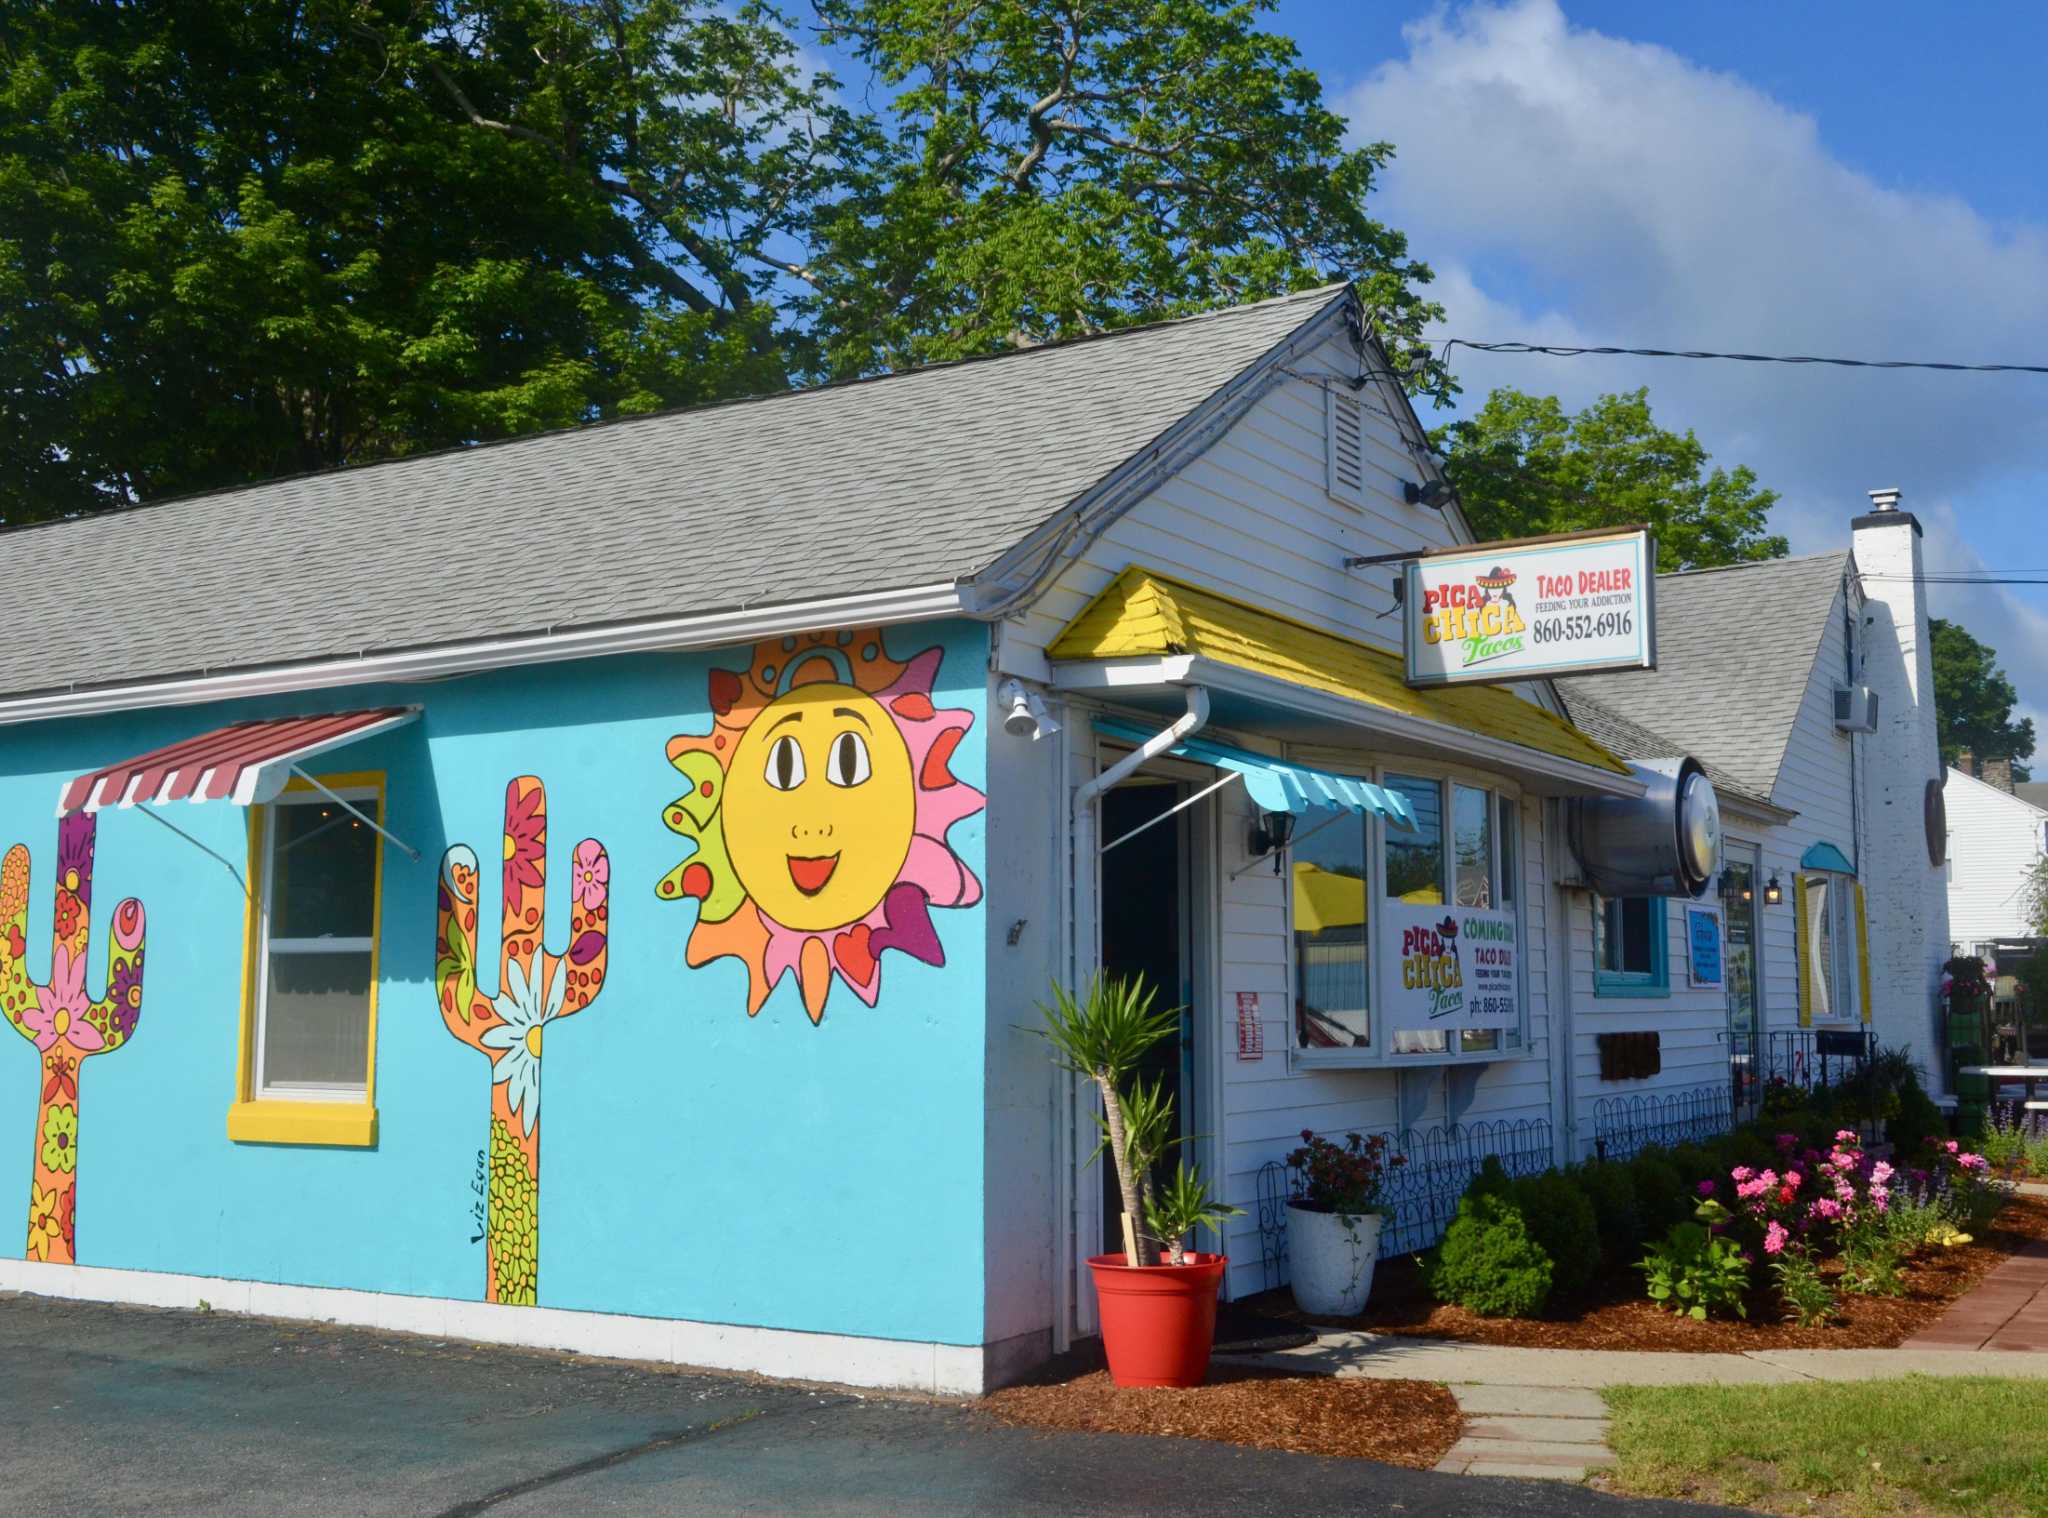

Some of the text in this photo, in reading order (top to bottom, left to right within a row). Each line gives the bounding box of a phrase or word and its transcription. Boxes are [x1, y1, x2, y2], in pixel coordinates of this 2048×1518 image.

[1423, 583, 1485, 614] PICA
[1537, 567, 1632, 599] TACO DEALER
[1535, 593, 1632, 613] FEEDING YOUR ADDICTION
[1534, 610, 1632, 645] 860-552-6916
[1461, 633, 1524, 664] Tacos
[1402, 926, 1442, 957] PICA
[1463, 917, 1504, 942] COMING
[1474, 947, 1497, 965] TACO
[1469, 995, 1482, 1019] ph:
[471, 1149, 487, 1196] Egan
